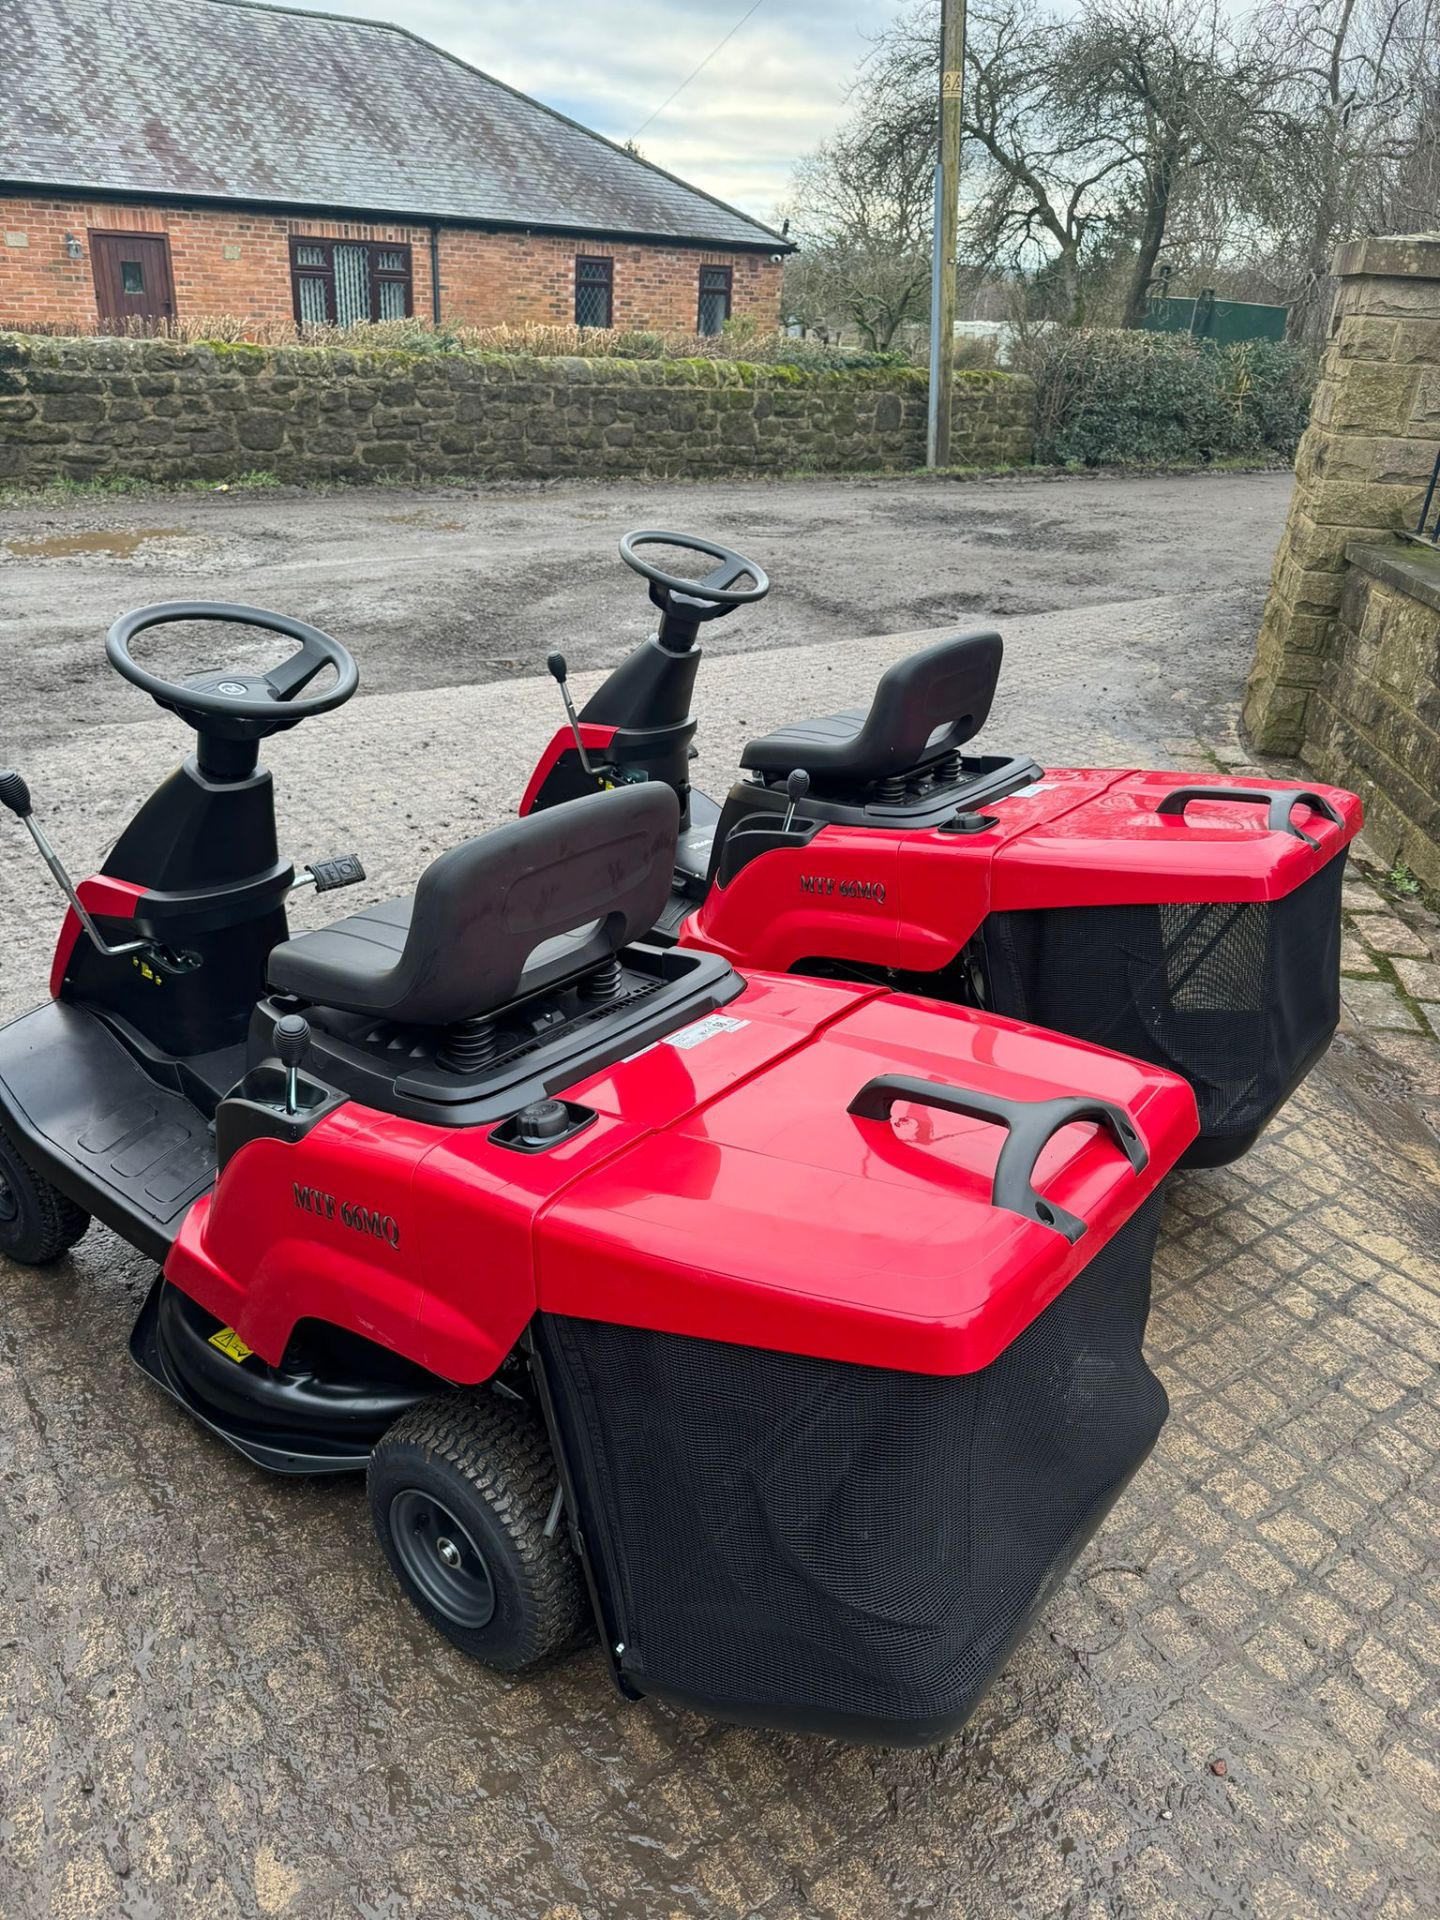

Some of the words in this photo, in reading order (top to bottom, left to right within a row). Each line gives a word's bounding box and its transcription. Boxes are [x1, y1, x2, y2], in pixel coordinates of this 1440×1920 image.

[800, 875, 836, 895] MTF
[839, 880, 886, 904] 66MQ
[293, 1182, 336, 1220] MTF
[340, 1201, 401, 1252] 66MQ
